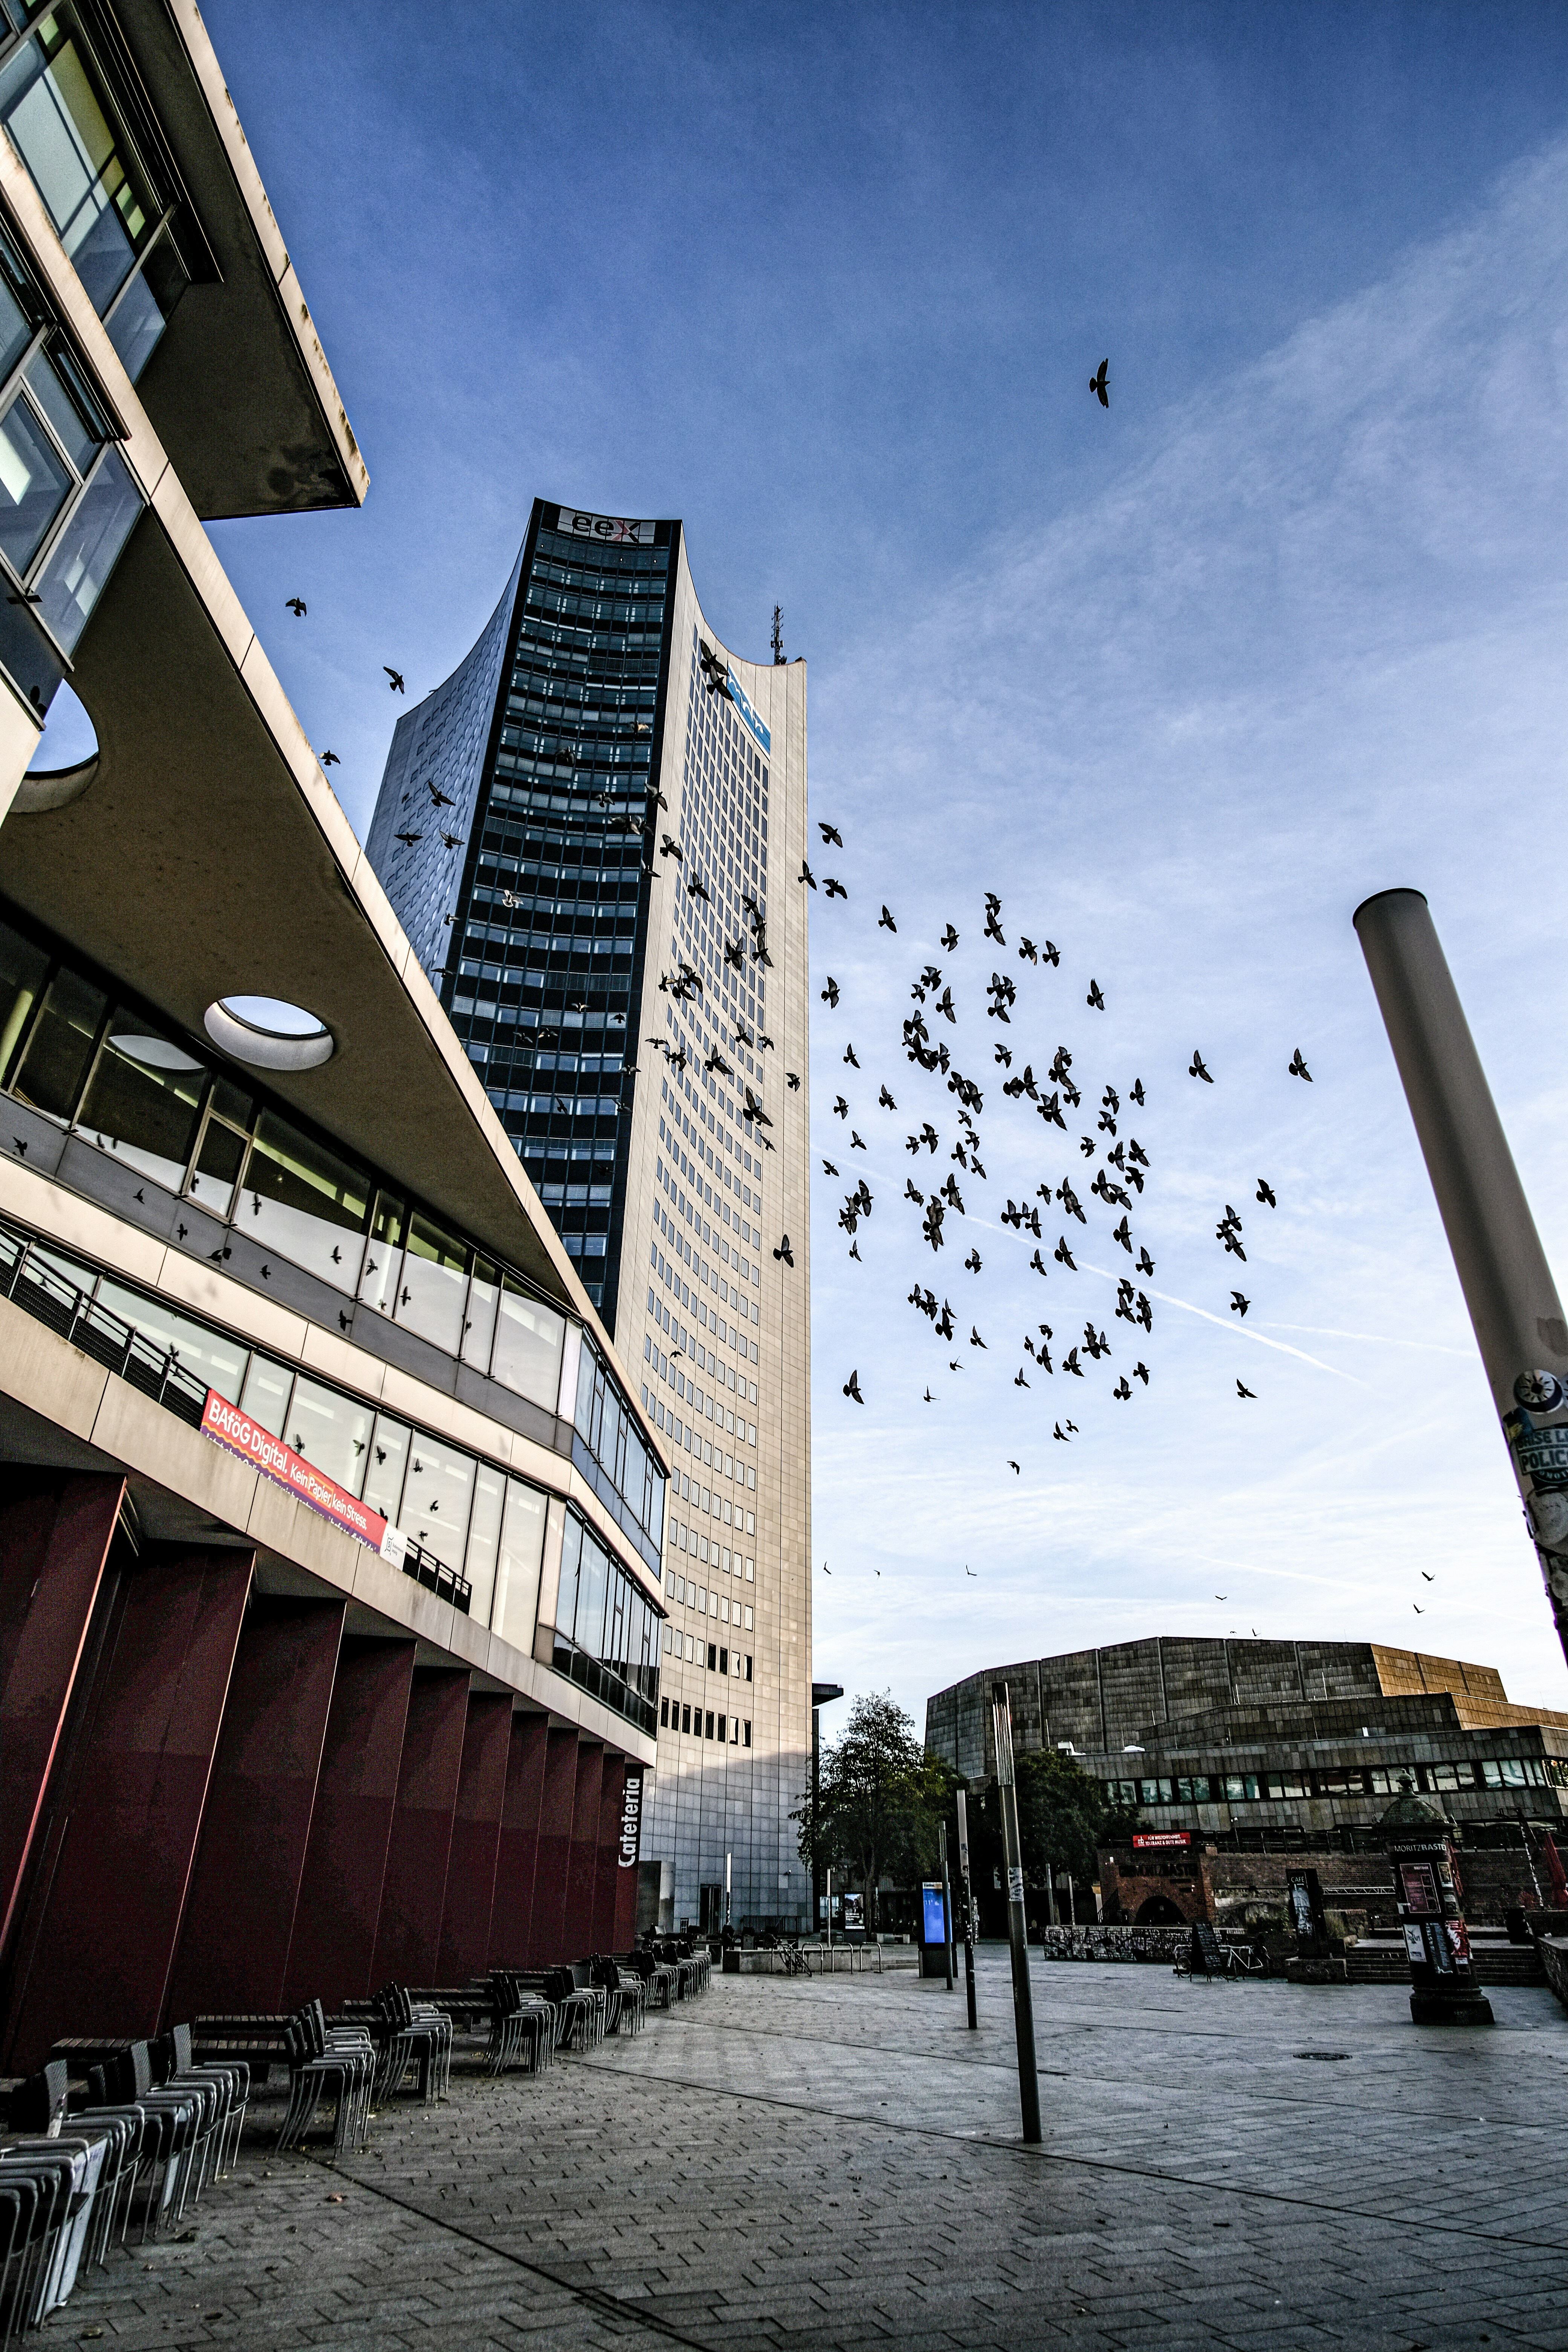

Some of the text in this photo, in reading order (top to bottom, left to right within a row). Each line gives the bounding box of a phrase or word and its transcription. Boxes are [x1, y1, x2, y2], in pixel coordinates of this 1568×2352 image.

[572, 516, 641, 543] eex
[208, 1398, 251, 1444] BAföG
[251, 1430, 288, 1473] Digital.
[290, 1463, 308, 1488] Kein
[308, 1476, 332, 1507] Papier,
[332, 1494, 346, 1515] kein
[1522, 1450, 1568, 1471] POLIC
[618, 1778, 640, 1867] Cafeteria
